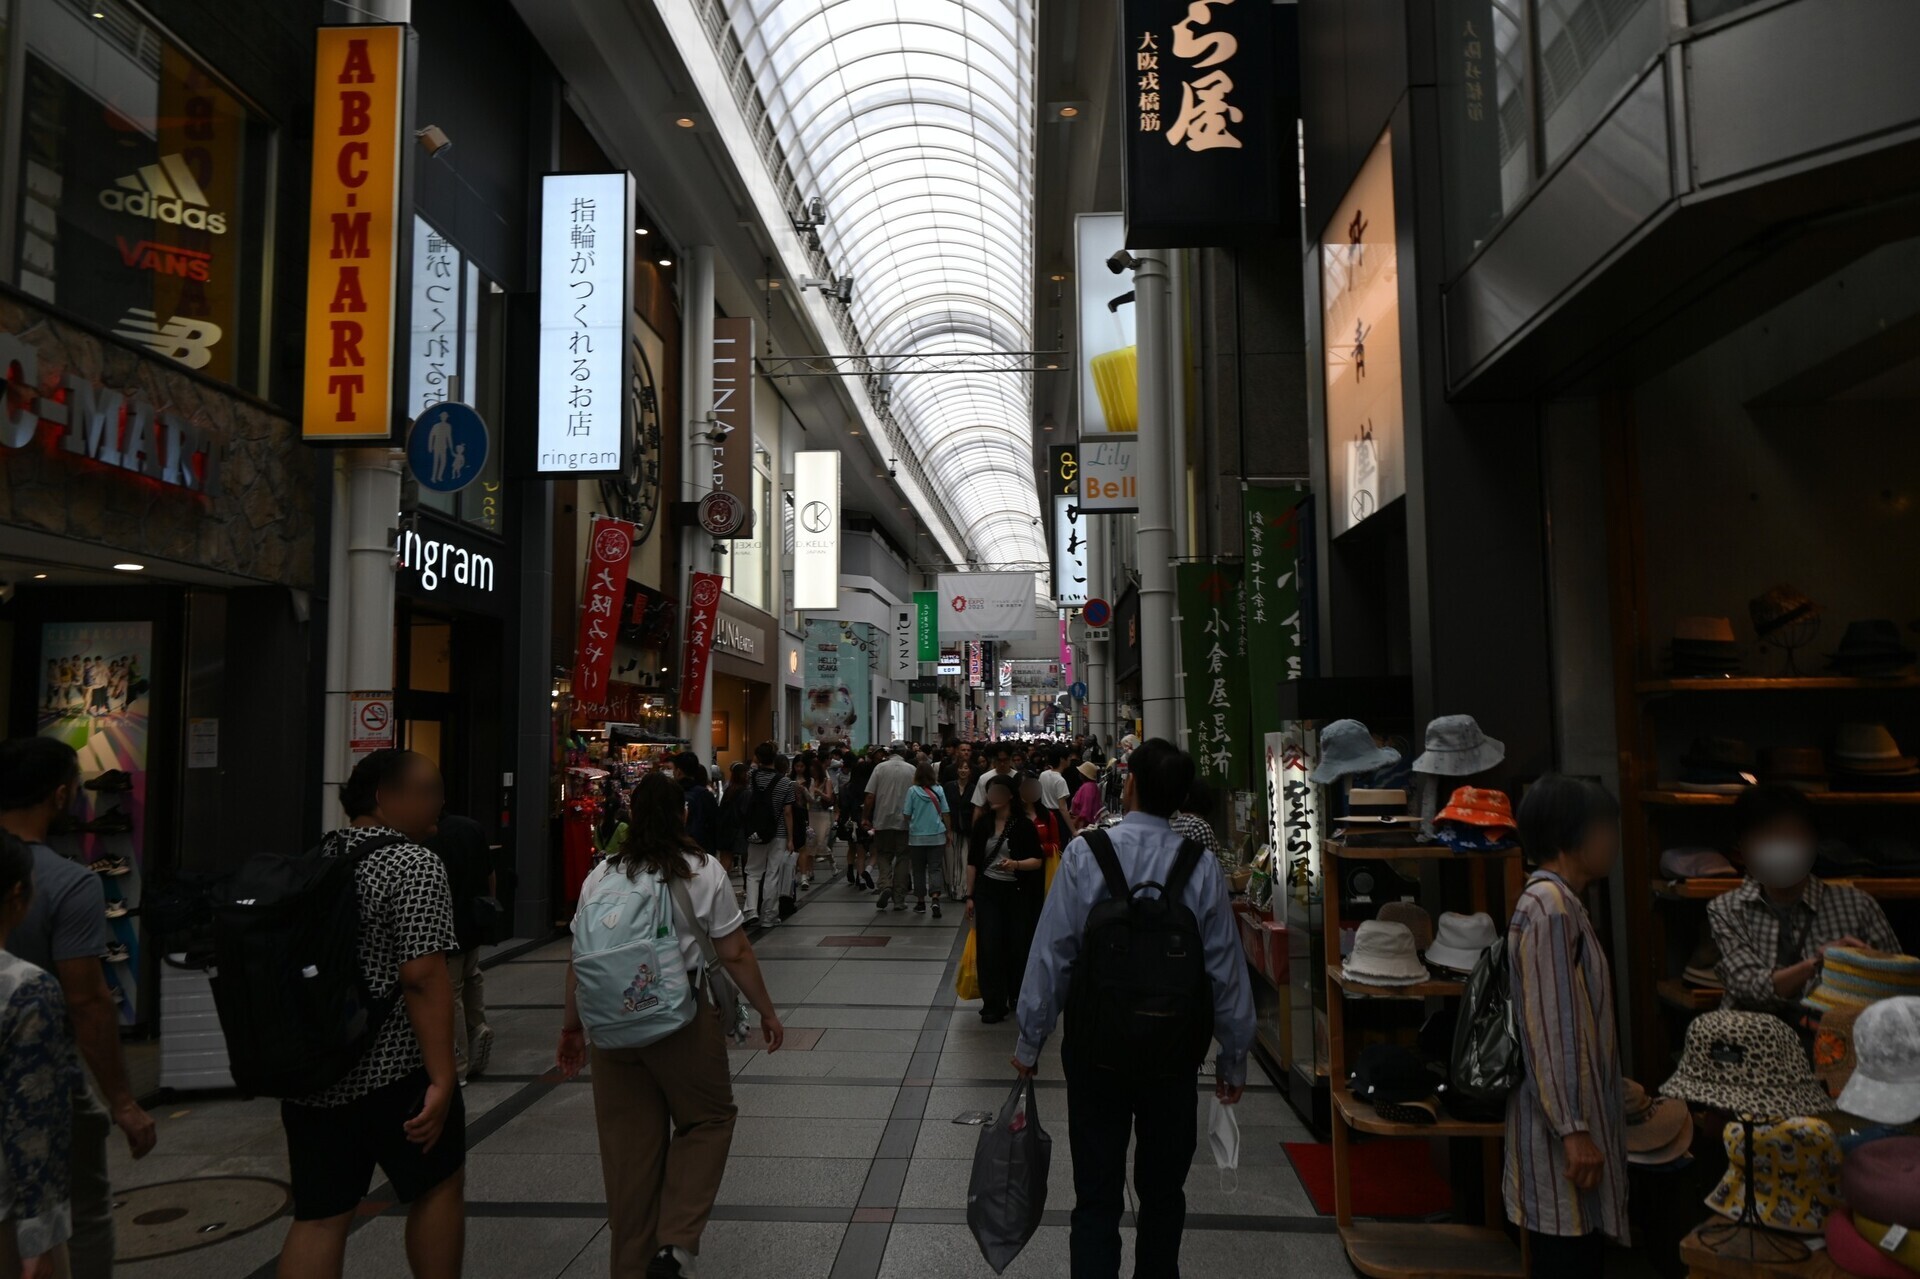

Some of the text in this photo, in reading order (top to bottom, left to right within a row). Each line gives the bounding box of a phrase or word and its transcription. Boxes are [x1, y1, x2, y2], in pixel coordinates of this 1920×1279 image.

[1137, 31, 1161, 132] 大阪戎橋筋
[1165, 0, 1244, 152] ら屋
[99, 188, 228, 235] adidas
[328, 39, 375, 422] ABC-MART
[116, 235, 213, 282] VANS
[566, 197, 596, 437] 指輪がつくれるお店
[542, 449, 617, 469] ringram
[1087, 443, 1130, 471] Lily
[1086, 476, 1136, 499] Bell
[717, 617, 739, 653] LUNA
[897, 613, 911, 670] DIANA
[1085, 630, 1109, 639] 自動車
[1203, 607, 1233, 780] 小倉屋昆布
